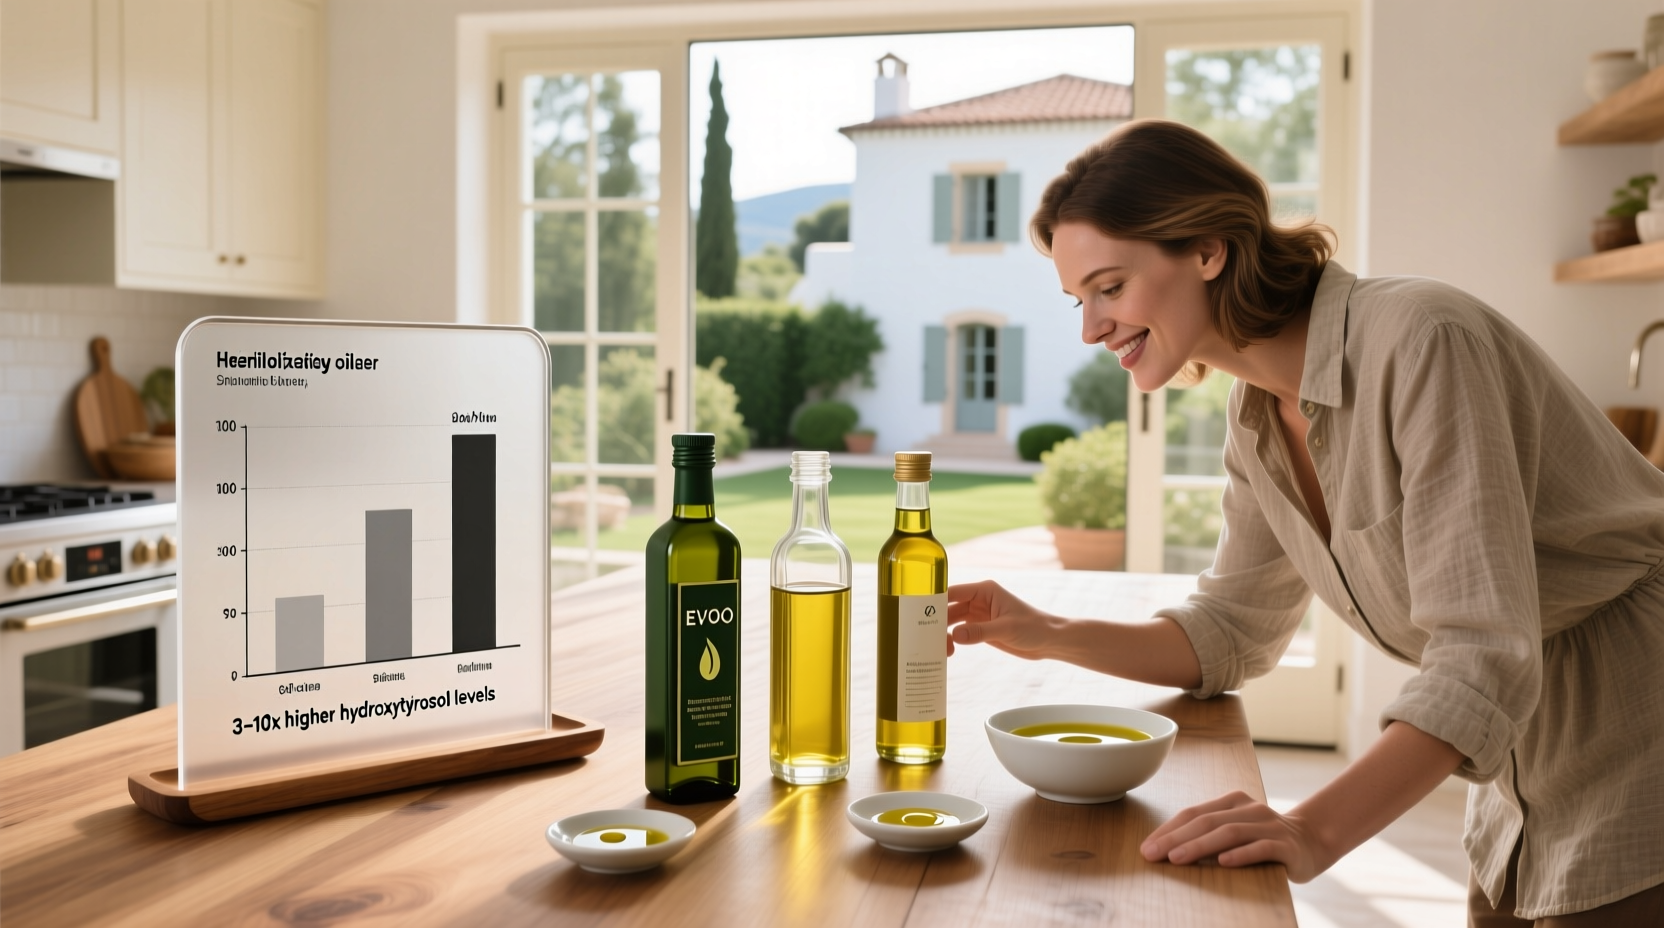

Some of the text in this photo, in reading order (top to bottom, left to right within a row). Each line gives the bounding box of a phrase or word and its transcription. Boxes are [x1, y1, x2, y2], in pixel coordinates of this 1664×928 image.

[216, 482, 237, 494] 100
[686, 606, 734, 627] EVOO
[284, 707, 336, 731] higher
[340, 690, 451, 725] hydroxytyrosol
[454, 685, 496, 706] levels
